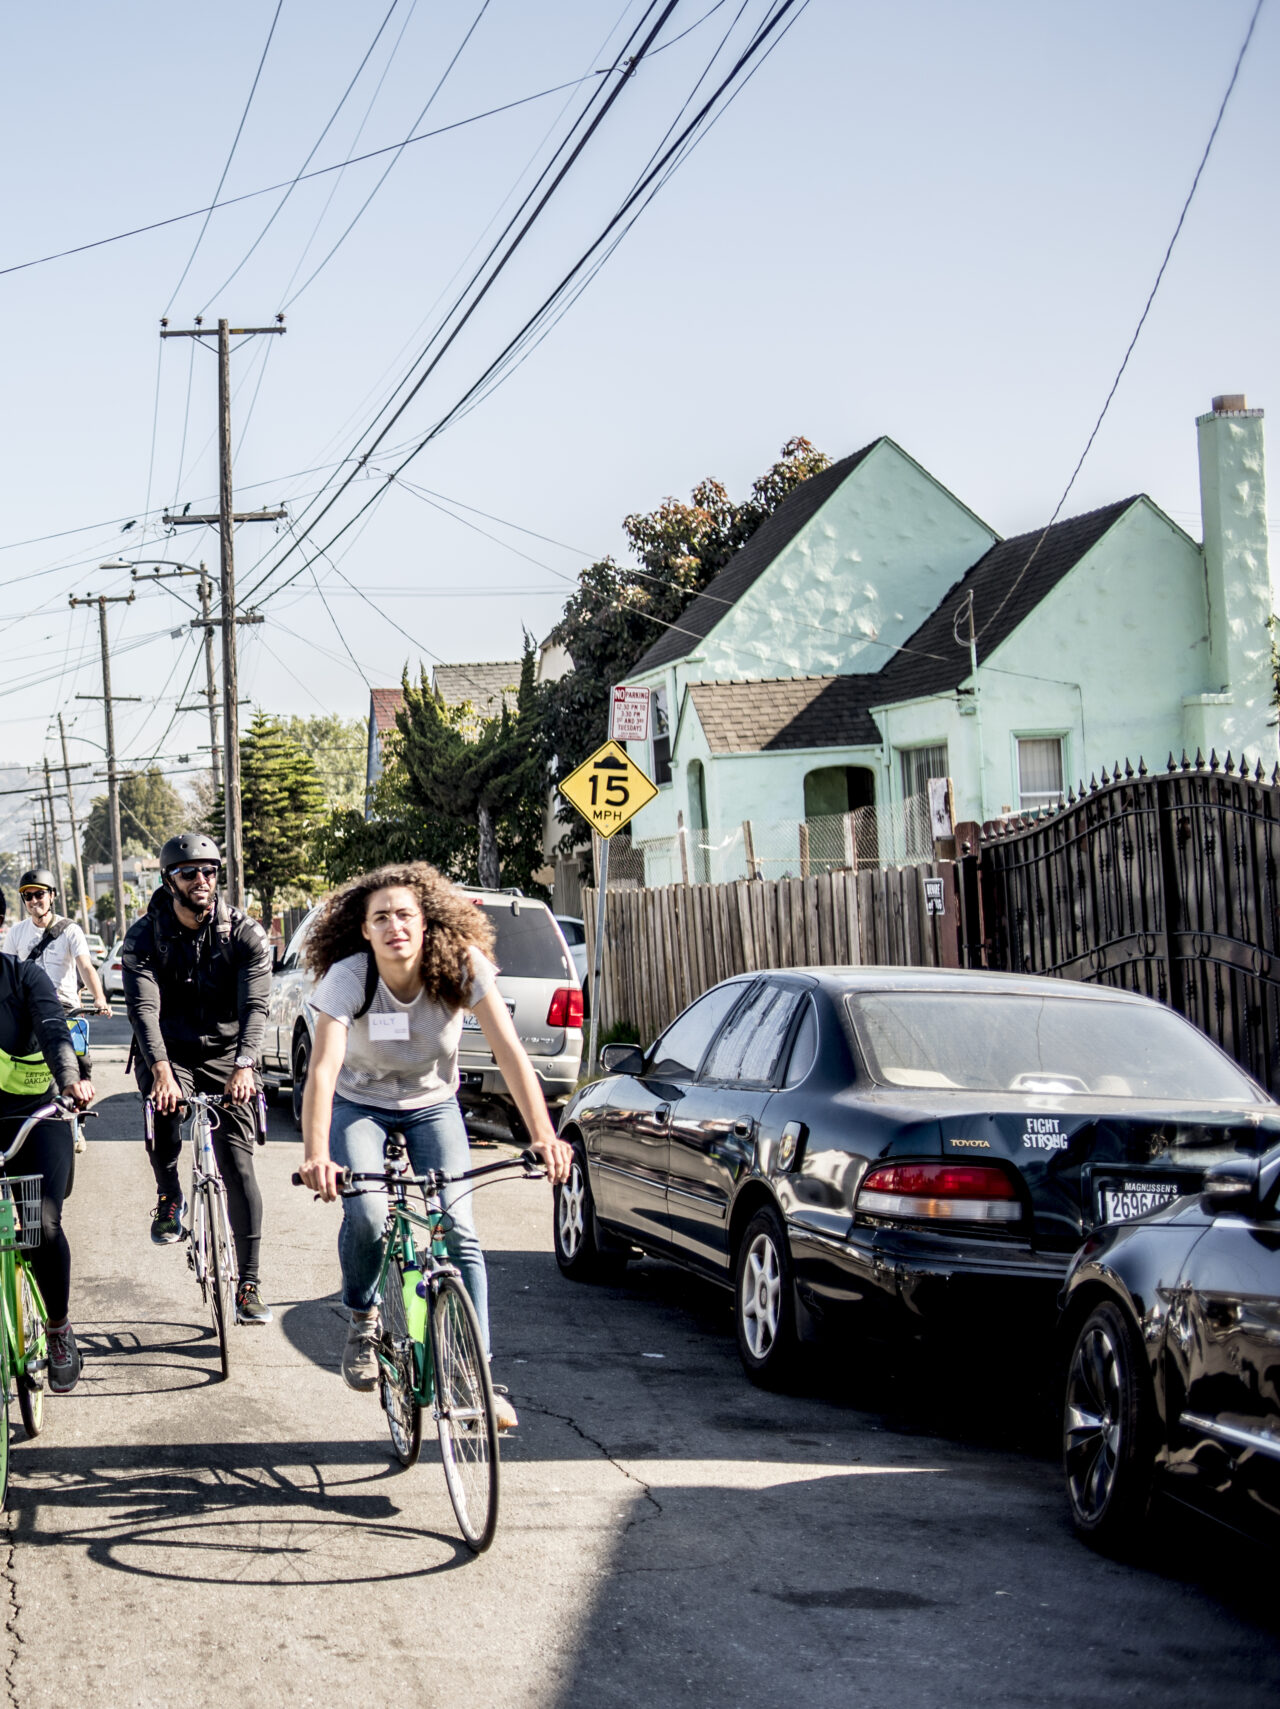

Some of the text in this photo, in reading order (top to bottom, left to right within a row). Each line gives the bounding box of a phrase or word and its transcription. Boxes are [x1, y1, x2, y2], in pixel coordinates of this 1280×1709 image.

[614, 690, 648, 700] NO PARKING
[618, 724, 642, 732] TUESDAYS
[589, 775, 629, 807] 15
[593, 810, 622, 821] MPH
[24, 1077, 52, 1085] OAKLAN
[1026, 1118, 1060, 1134] FIGHT
[950, 1139, 991, 1148] TOYOTA
[1022, 1133, 1068, 1151] STRONG
[1124, 1182, 1178, 1194] MAGNUSSEN'S
